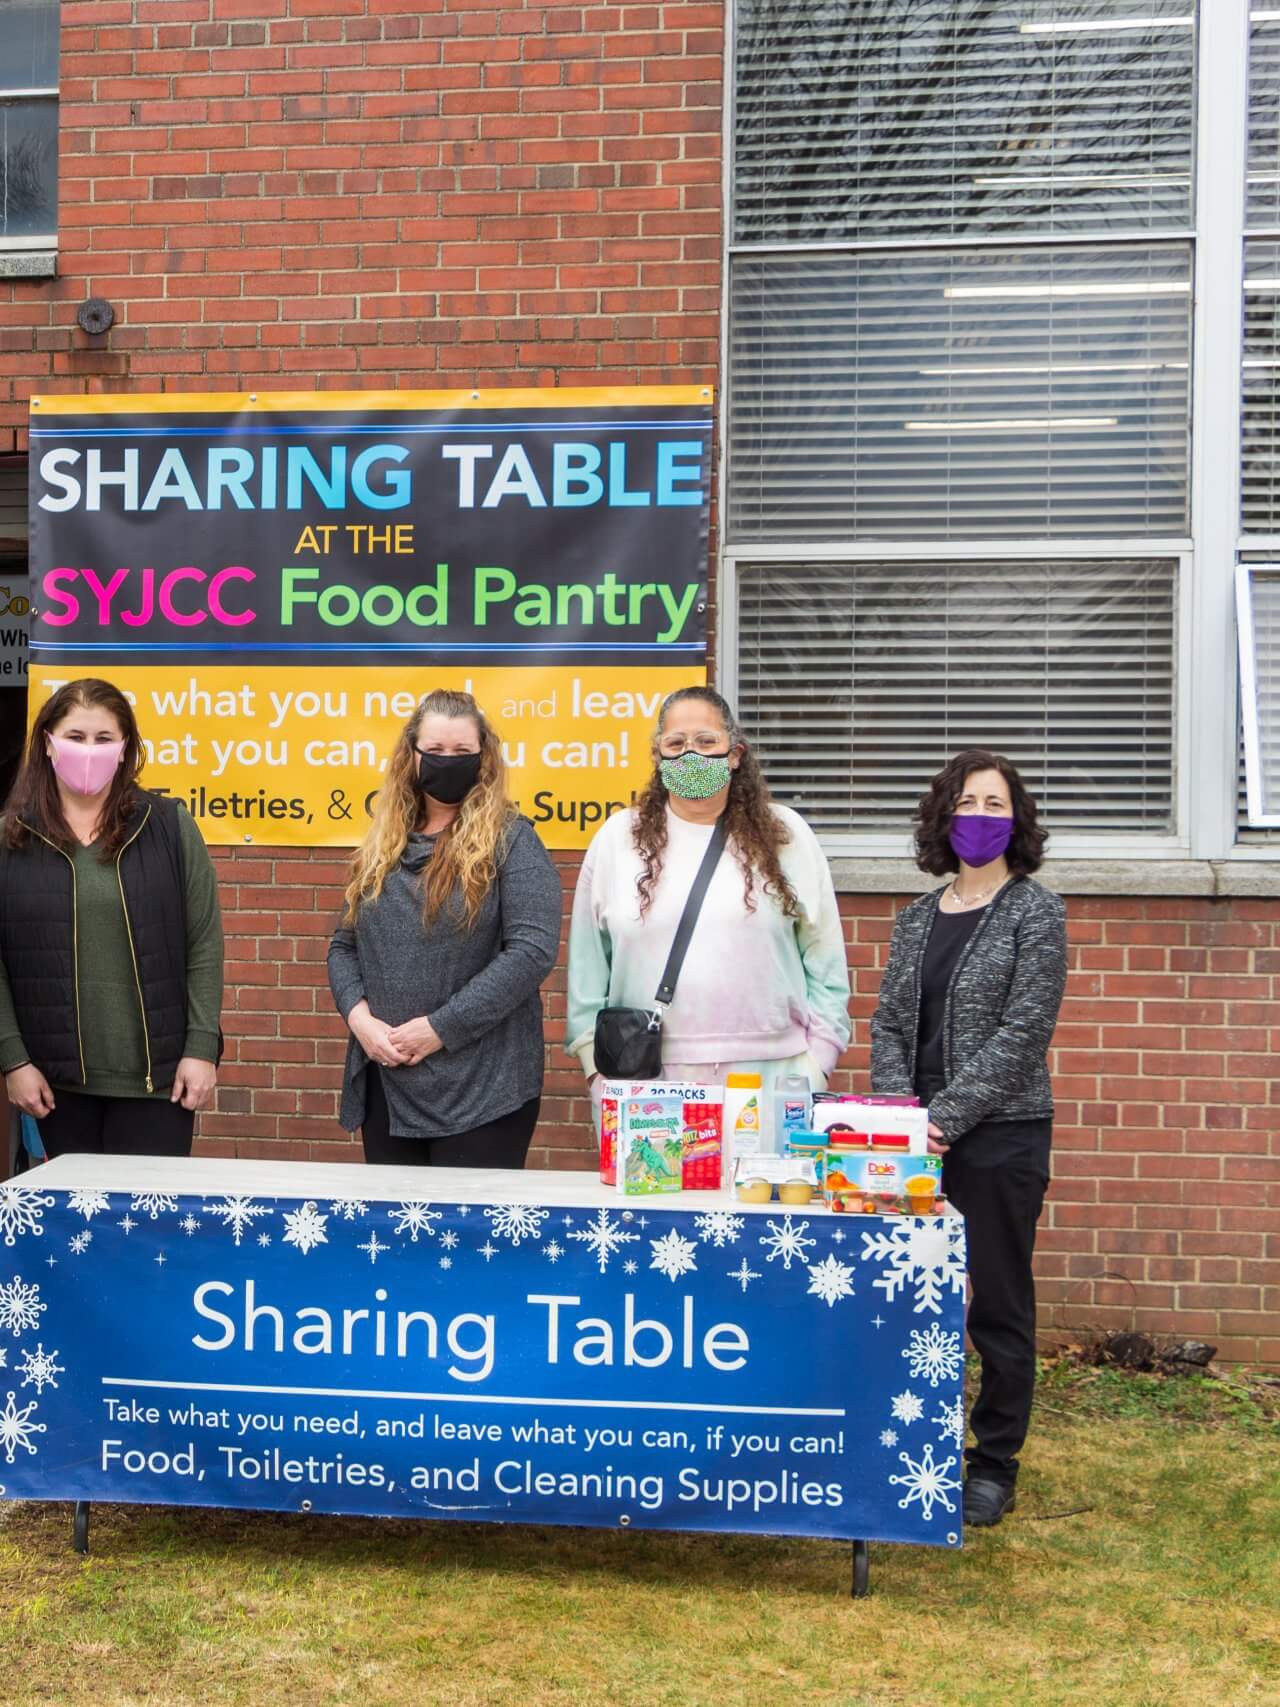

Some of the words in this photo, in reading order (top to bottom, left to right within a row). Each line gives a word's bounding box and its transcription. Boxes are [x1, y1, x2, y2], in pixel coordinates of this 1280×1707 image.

[37, 444, 412, 513] SHARING
[441, 441, 704, 509] TABLE
[293, 525, 339, 554] AT
[345, 524, 415, 554] THE
[40, 566, 257, 627] SYJCC
[280, 564, 449, 627] Food
[473, 566, 700, 644] Pantry
[0, 629, 29, 648] Wh
[151, 677, 257, 717] what
[269, 690, 348, 728] you
[500, 689, 557, 718] and
[210, 739, 289, 777] you
[303, 738, 389, 772] can,
[540, 731, 630, 768] can!
[326, 789, 353, 820] &
[868, 1162, 896, 1175] Dole
[191, 1280, 495, 1382] Sharing
[527, 1293, 750, 1371] Table
[104, 1398, 160, 1424] Take
[168, 1403, 230, 1429] what
[237, 1413, 284, 1436] you
[294, 1410, 366, 1439] need,
[375, 1413, 424, 1438] and
[434, 1414, 502, 1442] leave
[511, 1418, 577, 1445] what
[584, 1429, 633, 1452] you
[642, 1430, 696, 1454] can,
[707, 1425, 724, 1450] if
[730, 1434, 780, 1458] you
[789, 1431, 844, 1456] can!
[102, 1439, 205, 1481] Food,
[218, 1446, 395, 1492] Toiletries,
[410, 1457, 479, 1491] and
[494, 1460, 663, 1509] Cleaning
[678, 1467, 843, 1512] Supplies
